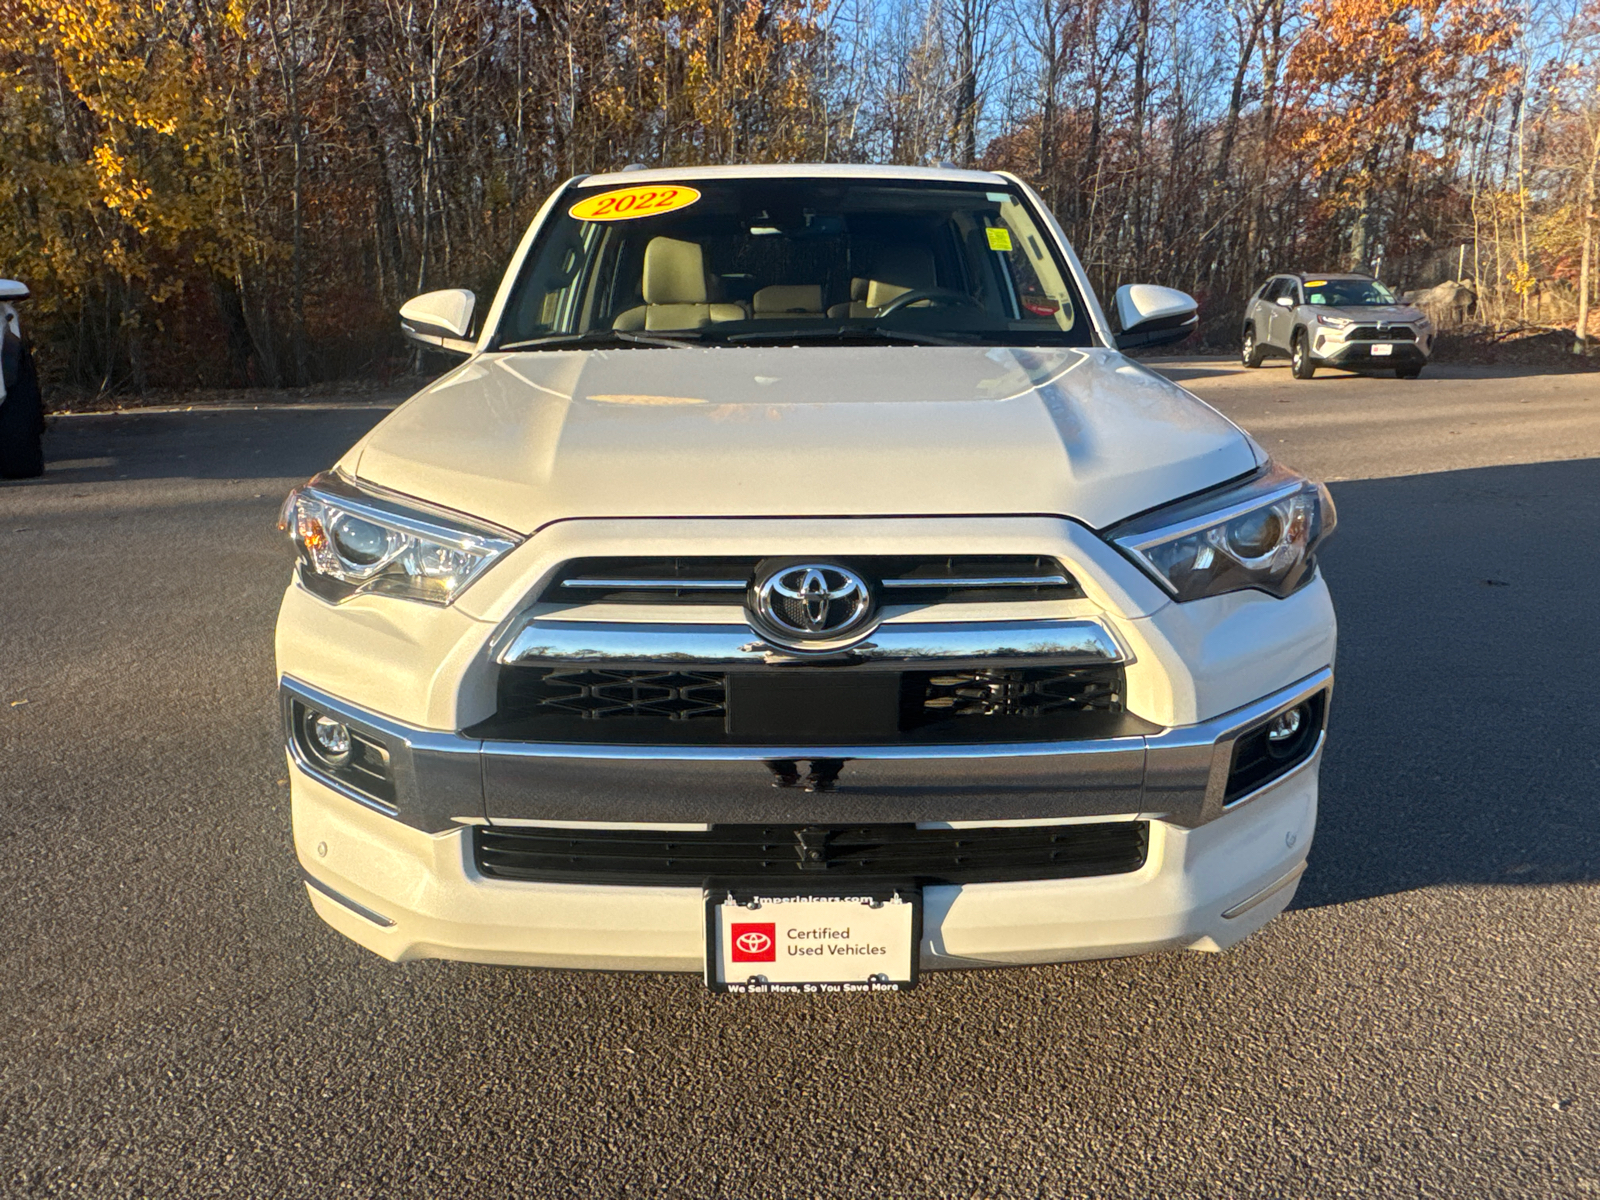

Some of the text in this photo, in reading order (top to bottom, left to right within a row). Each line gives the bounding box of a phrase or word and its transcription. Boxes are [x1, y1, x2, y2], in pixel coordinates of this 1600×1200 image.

[591, 190, 679, 217] 2022
[787, 927, 850, 940] Certified
[787, 944, 887, 956] Used Vehicles
[728, 983, 899, 994] We Sell More, So You Save More
